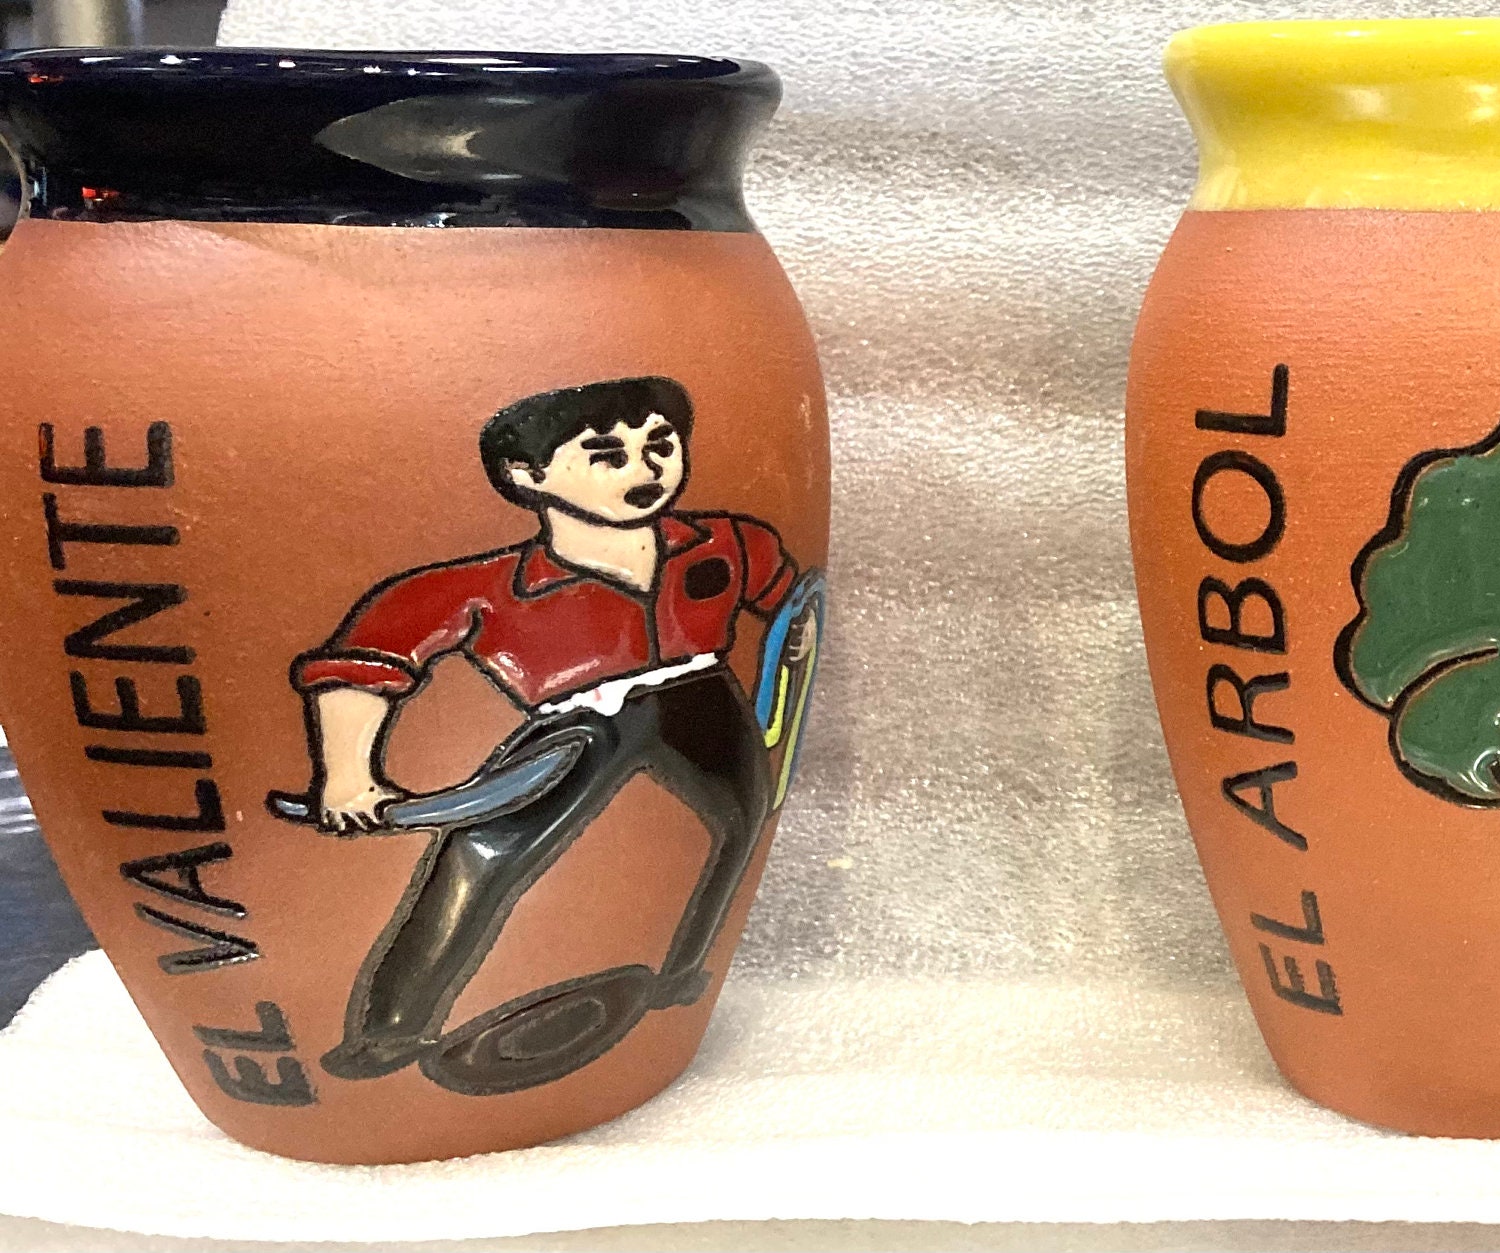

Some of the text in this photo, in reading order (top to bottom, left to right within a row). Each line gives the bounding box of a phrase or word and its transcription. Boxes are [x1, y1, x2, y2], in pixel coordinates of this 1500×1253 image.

[37, 419, 320, 1107] EL VALIENTE
[1191, 362, 1344, 1017] EL ARBOL
